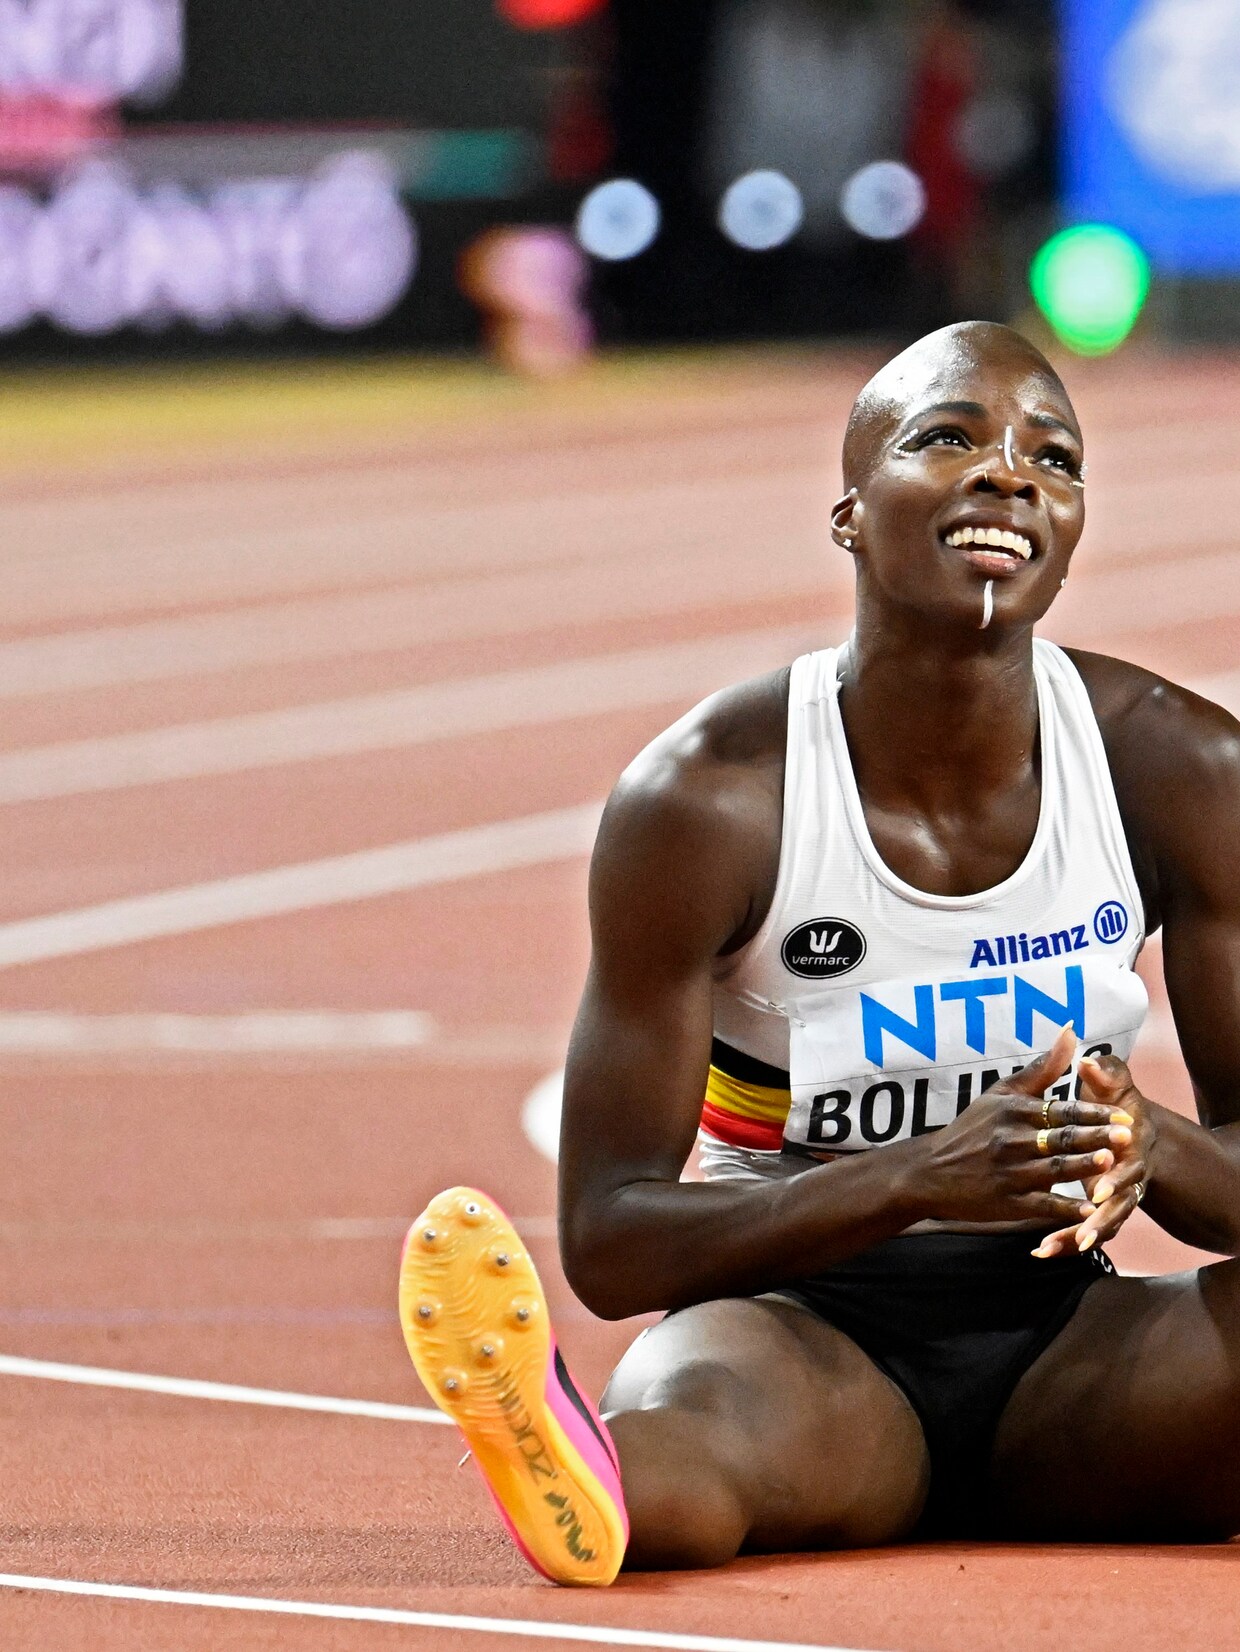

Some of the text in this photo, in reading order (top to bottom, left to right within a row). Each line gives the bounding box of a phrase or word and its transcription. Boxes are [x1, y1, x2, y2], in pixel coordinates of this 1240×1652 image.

[791, 954, 850, 967] vermarc
[969, 923, 1090, 969] Allianz
[859, 964, 1085, 1069] NTN
[806, 1042, 1113, 1144] BOLI
